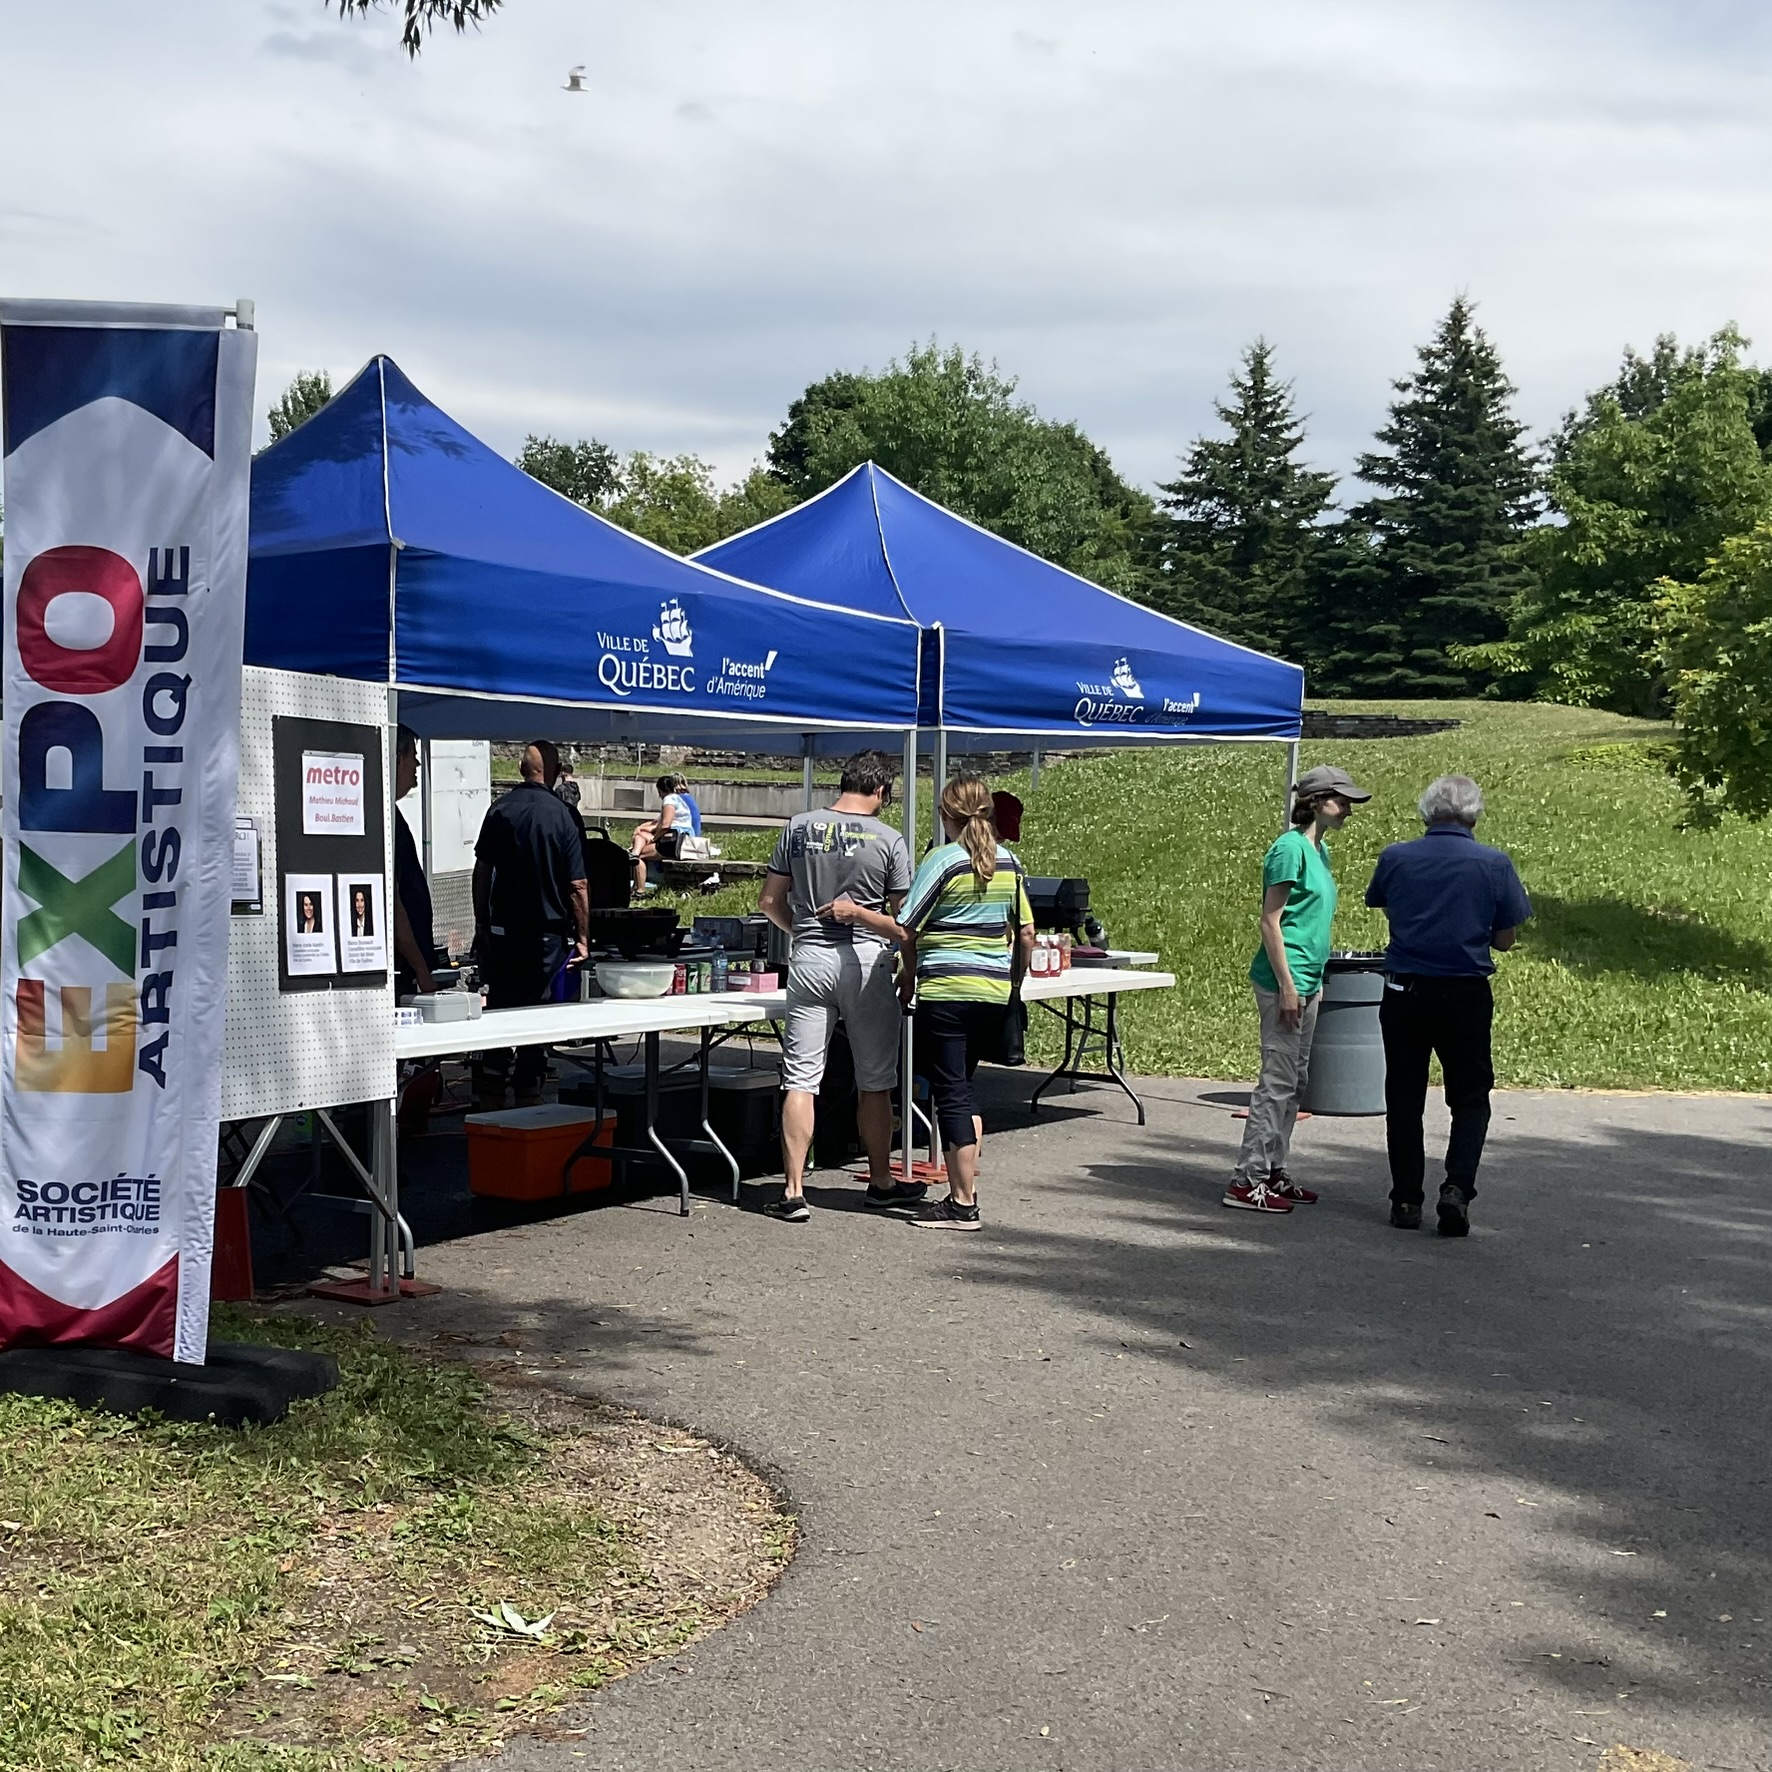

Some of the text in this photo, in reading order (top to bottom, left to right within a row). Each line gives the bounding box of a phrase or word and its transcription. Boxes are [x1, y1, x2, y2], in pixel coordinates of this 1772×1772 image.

[633, 638, 649, 653] DE
[598, 653, 695, 696] QUÉBEC
[722, 657, 765, 679] l'accent
[707, 676, 766, 700] d'Amérique
[1102, 686, 1114, 696] DE
[1074, 697, 1144, 727] QUÉBEC
[306, 766, 360, 786] metro
[308, 796, 334, 805] Mathieu
[15, 545, 143, 1093] EXPO
[139, 546, 192, 1089] ARTISTIQUE
[17, 1172, 161, 1205] SOCIÉTÉ
[14, 1203, 160, 1223] ARTISTIQUE
[12, 1224, 159, 1236] de la Haute-Saint-Charles
